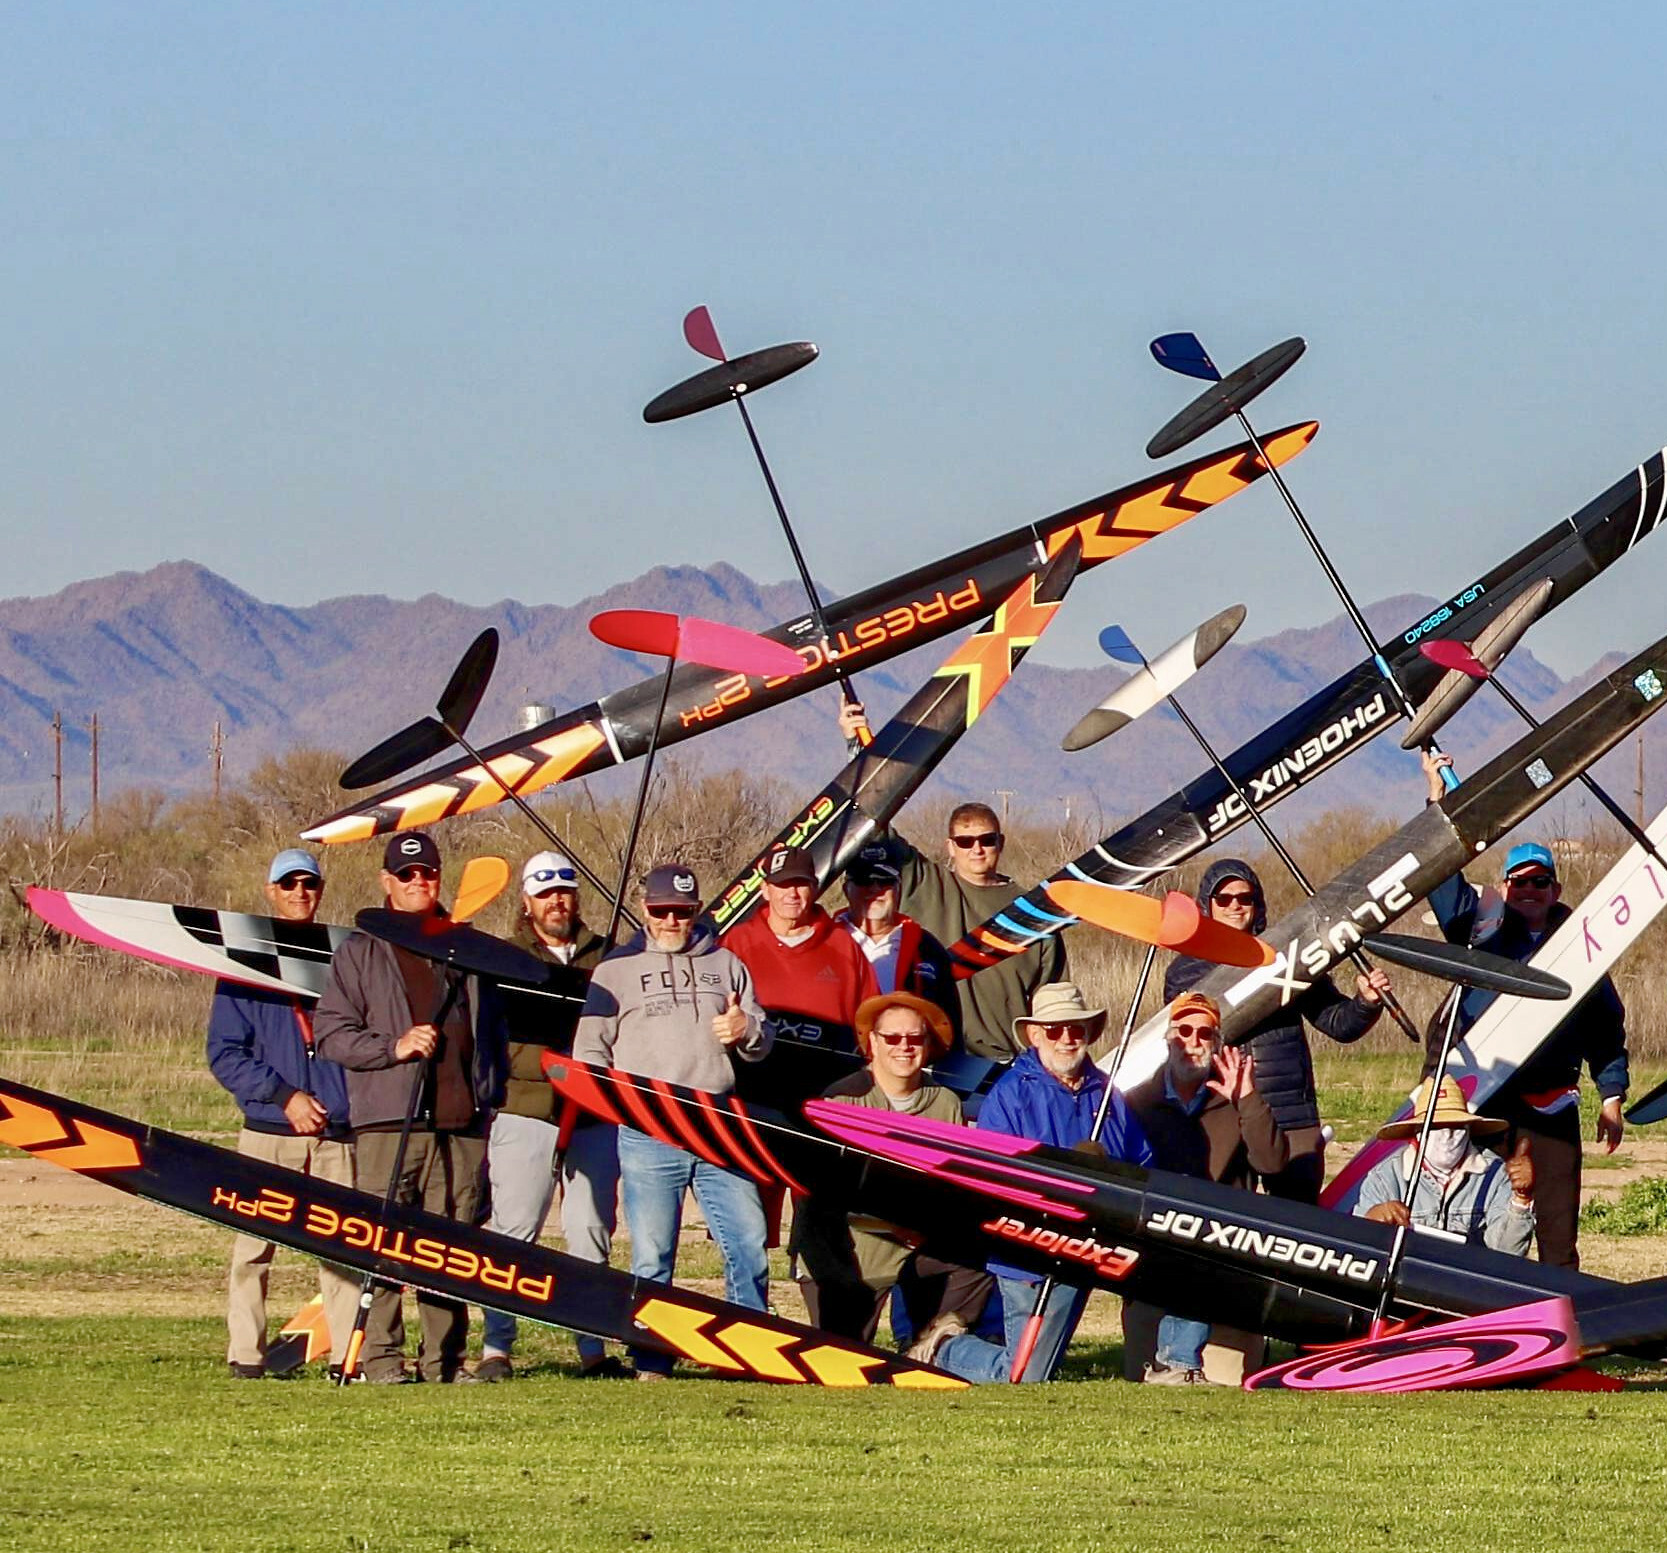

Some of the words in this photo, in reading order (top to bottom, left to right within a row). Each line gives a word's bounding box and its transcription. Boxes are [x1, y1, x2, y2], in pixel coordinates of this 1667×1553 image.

[1455, 583, 1486, 609] USA
[1249, 692, 1386, 802] PHOENIX
[1264, 878, 1413, 1007] PLUSX
[306, 1204, 556, 1300] PRESTIGE
[984, 1216, 1142, 1281] Explorer
[1147, 1209, 1203, 1239] DF
[1208, 1220, 1378, 1283] PHOENIX
